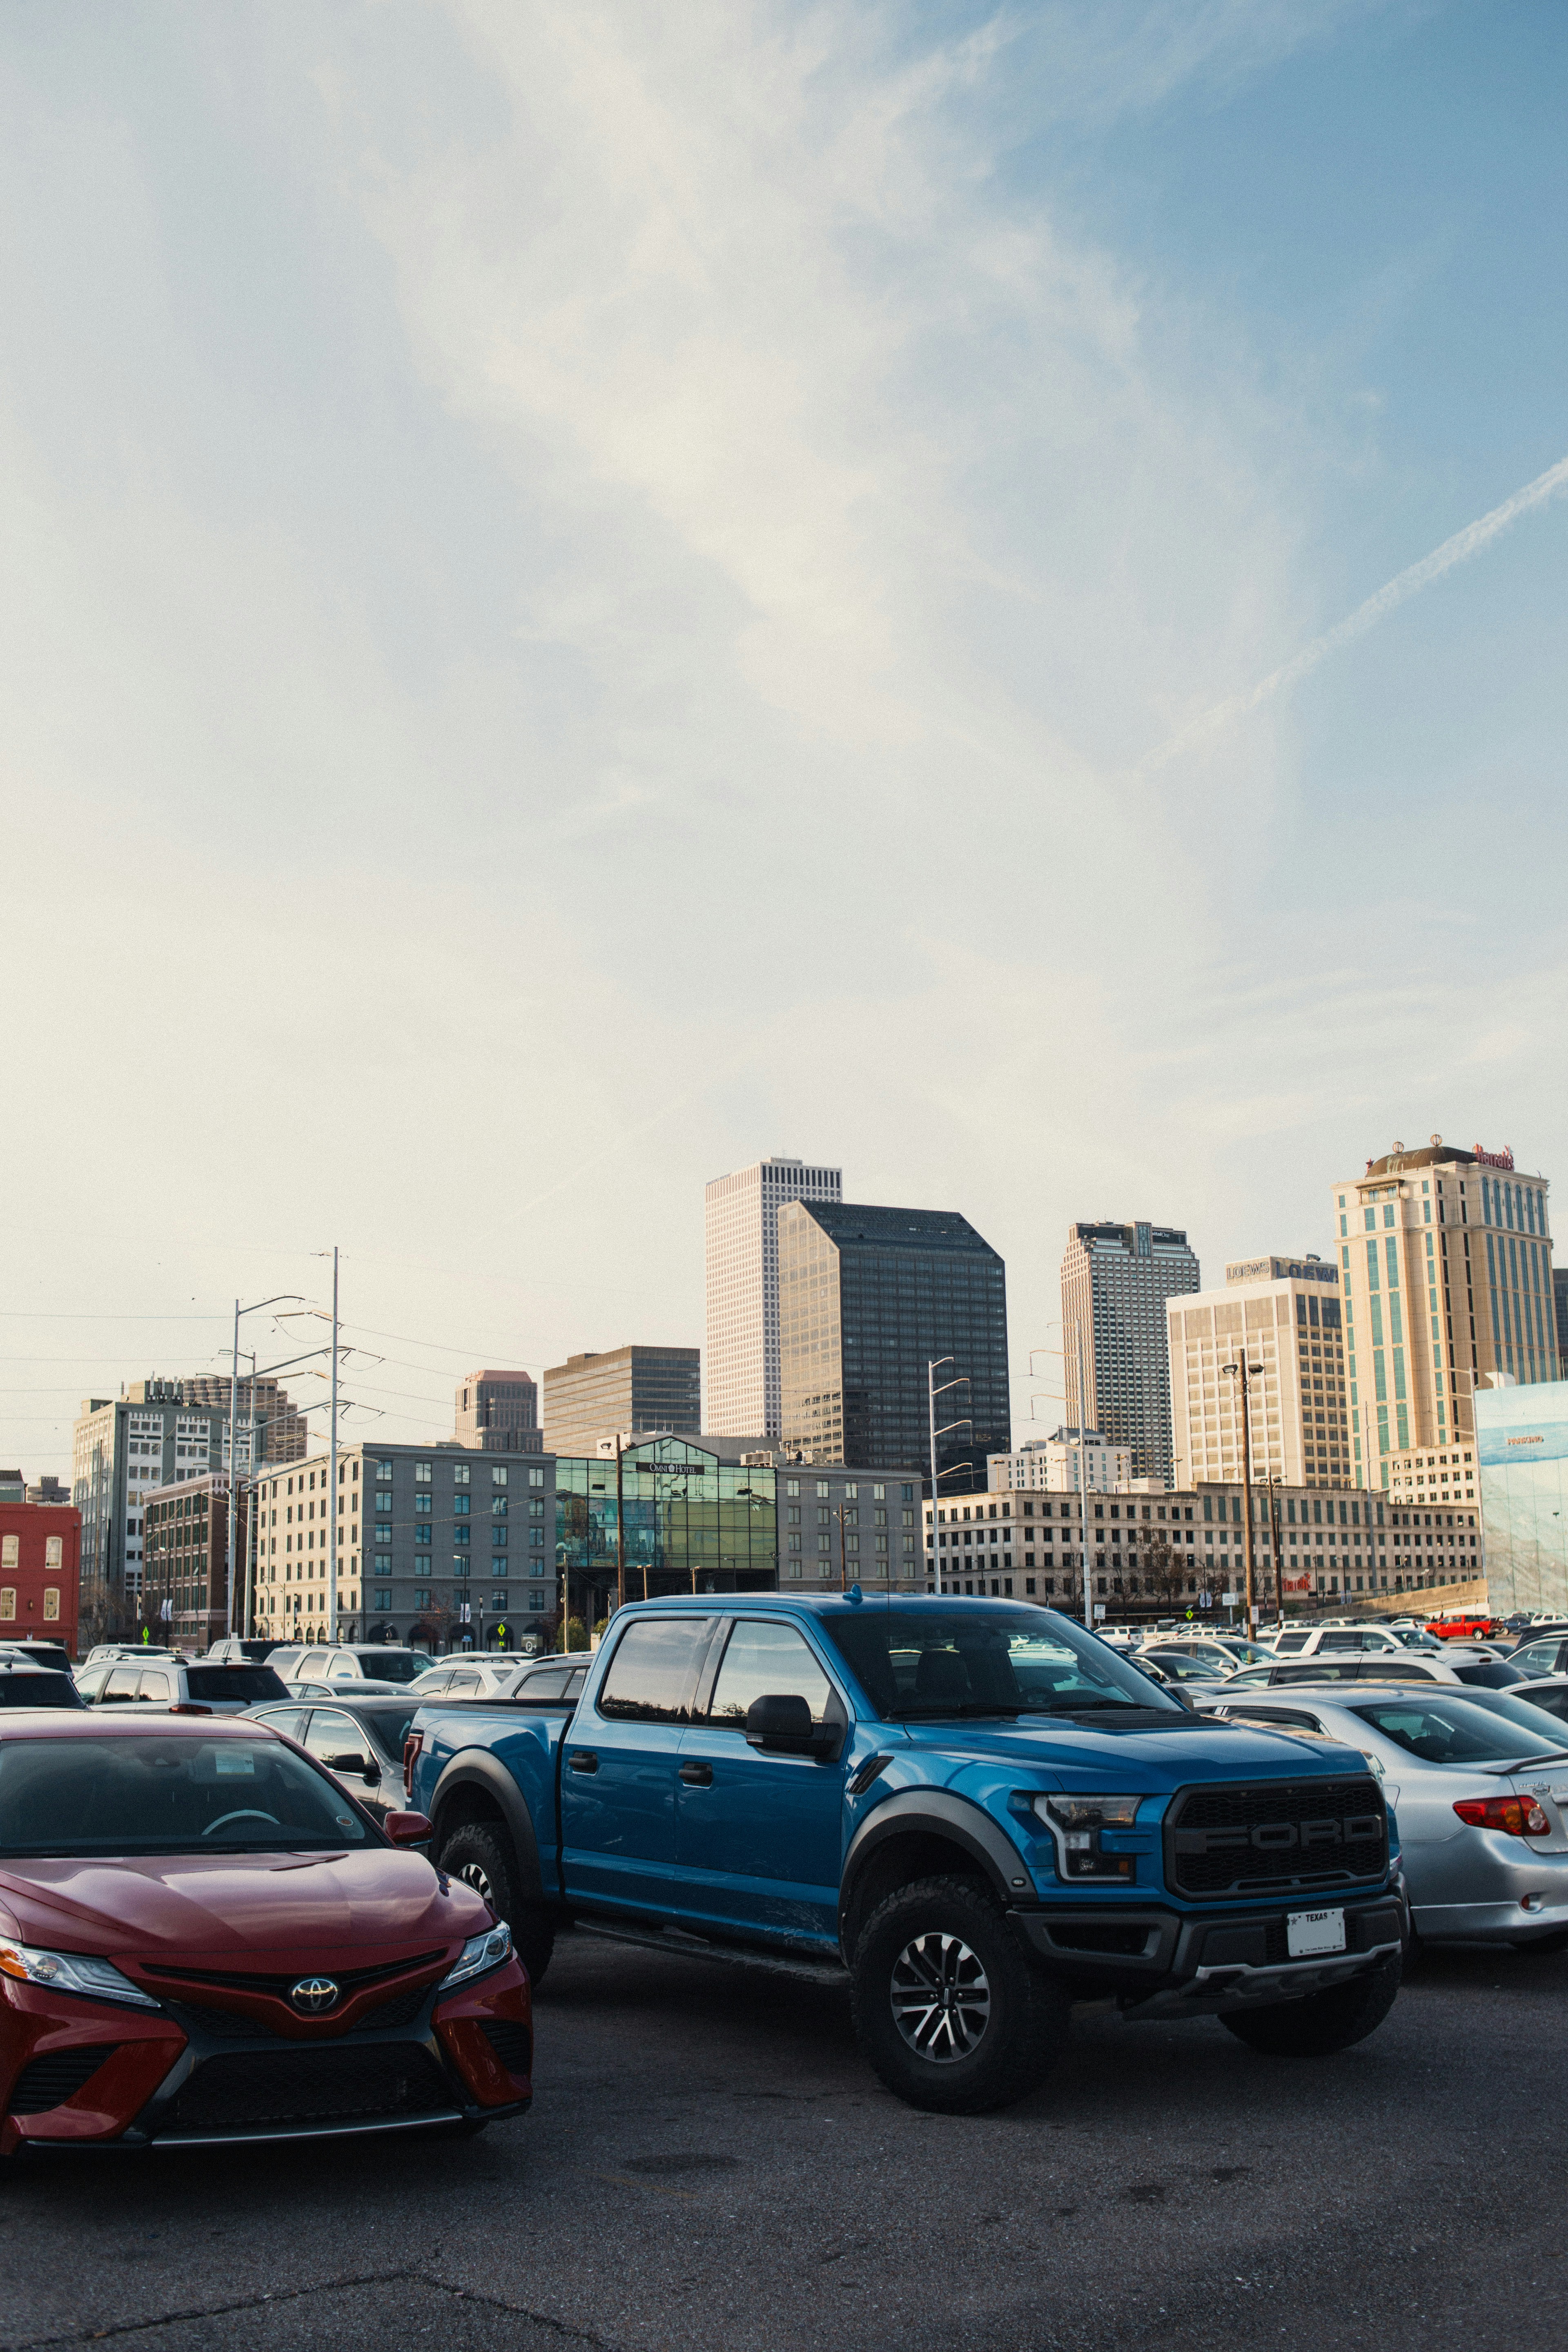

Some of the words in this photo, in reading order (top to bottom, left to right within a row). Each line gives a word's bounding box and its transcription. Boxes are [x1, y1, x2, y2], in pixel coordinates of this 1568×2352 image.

[1227, 1261, 1269, 1279] LOEWS
[1507, 1436, 1543, 1445] PARKING
[1182, 1815, 1382, 1853] FORD
[1306, 1912, 1327, 1922] TEXAS
